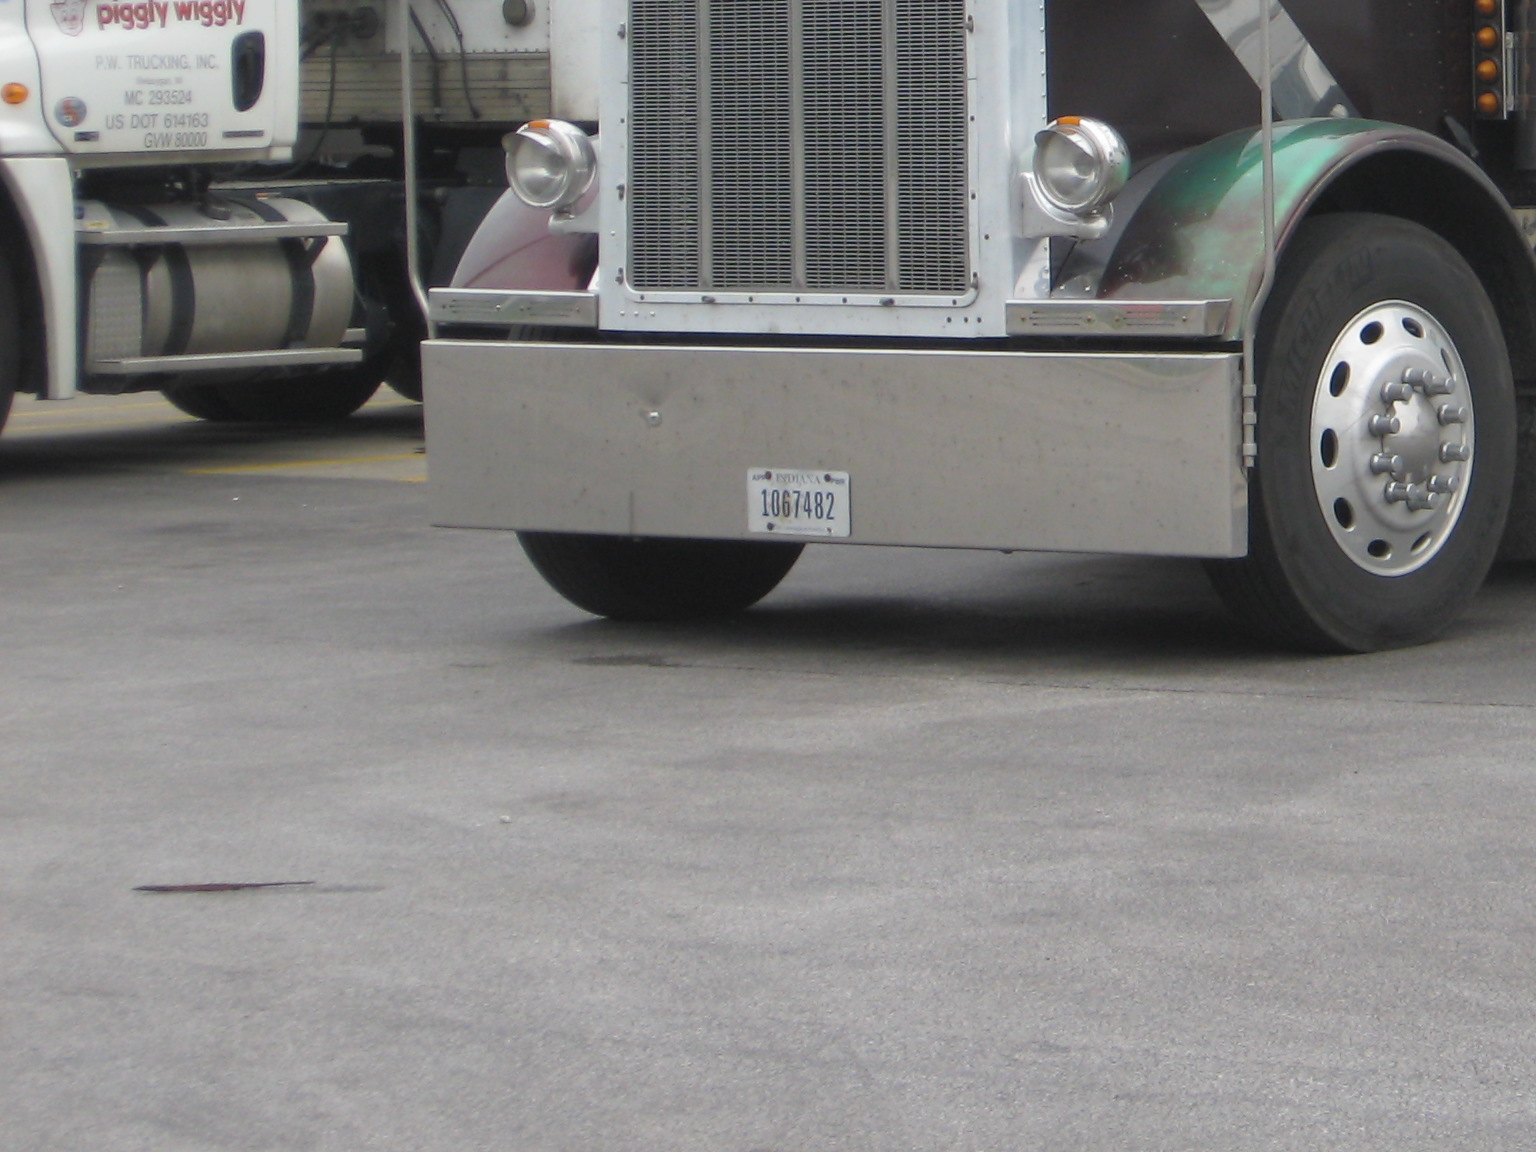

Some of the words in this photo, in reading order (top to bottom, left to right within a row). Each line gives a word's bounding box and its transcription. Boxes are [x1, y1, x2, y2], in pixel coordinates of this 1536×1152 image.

[196, 54, 220, 69] INC.
[124, 90, 143, 105] MC
[148, 89, 193, 105] 293524
[106, 114, 124, 129] US
[130, 113, 158, 129] DOT
[164, 113, 209, 129] 614163
[144, 132, 173, 148] GVW
[174, 131, 208, 148] 80000
[775, 473, 821, 485] INDIANA
[761, 489, 835, 520] 1067482
